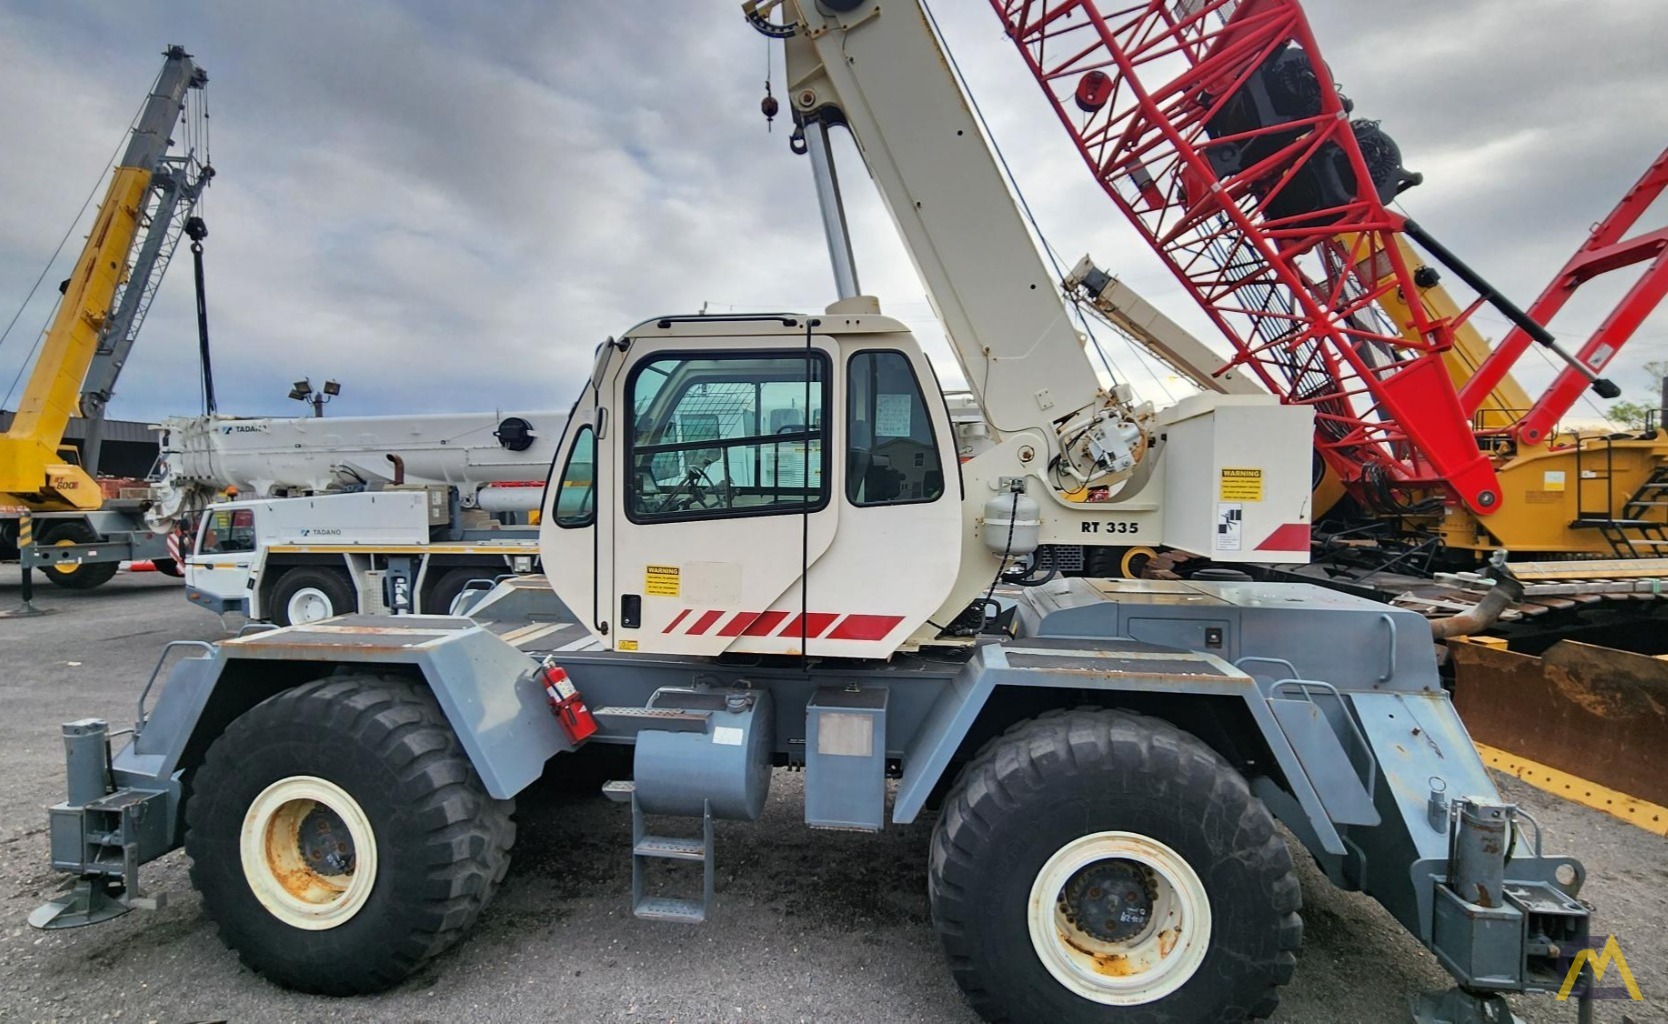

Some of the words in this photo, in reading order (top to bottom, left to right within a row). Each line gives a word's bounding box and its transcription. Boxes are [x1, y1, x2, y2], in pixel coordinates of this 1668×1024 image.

[1081, 521, 1100, 532] RT
[1106, 522, 1139, 533] 335
[648, 567, 678, 575] WARNING
